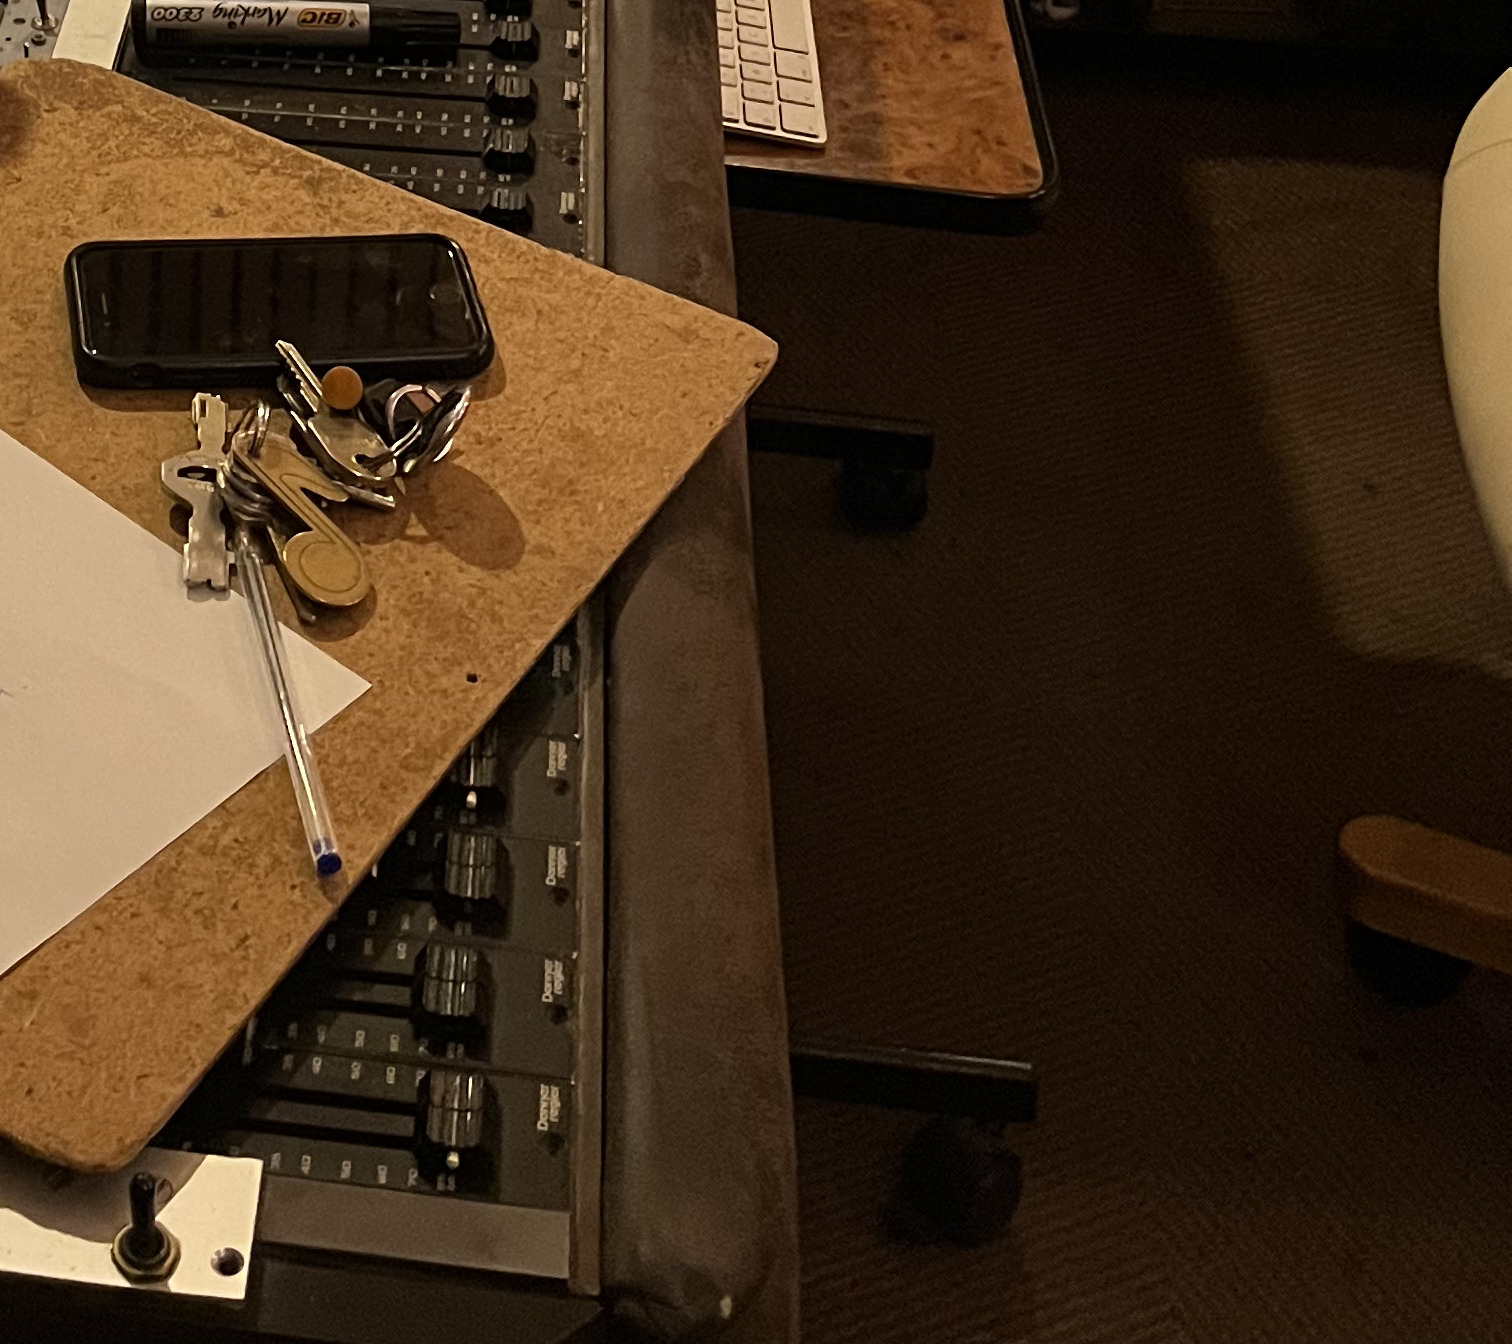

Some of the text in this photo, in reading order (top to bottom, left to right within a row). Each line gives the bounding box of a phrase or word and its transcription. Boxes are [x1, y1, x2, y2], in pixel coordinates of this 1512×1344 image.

[151, 2, 342, 30] BIC Marking 2300
